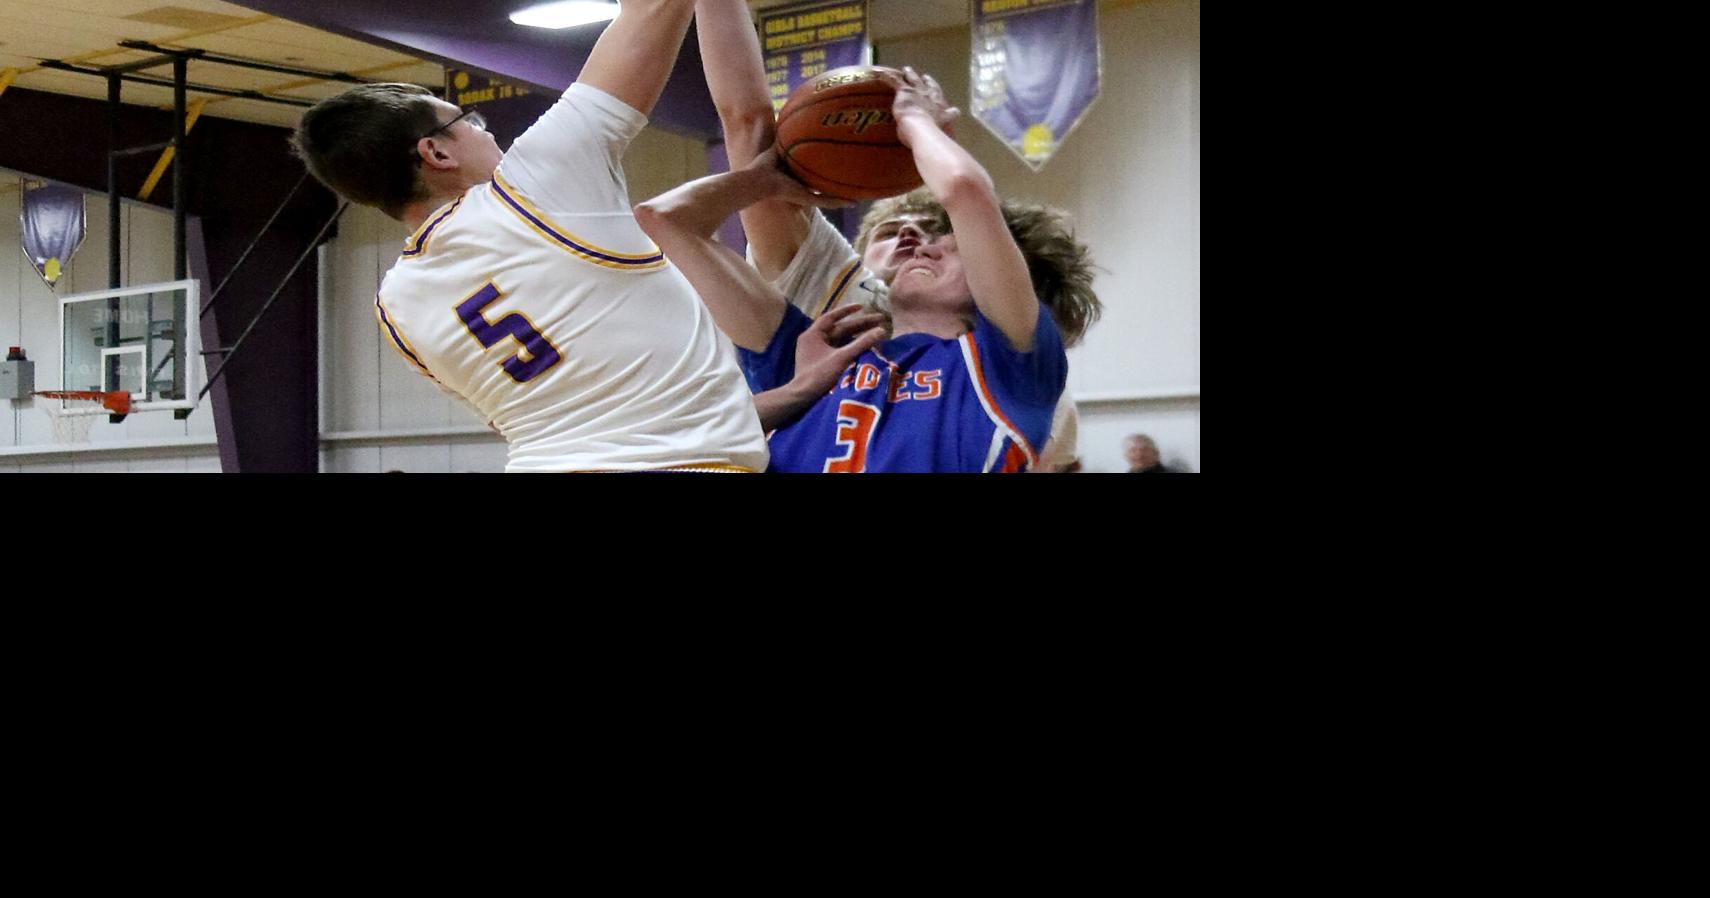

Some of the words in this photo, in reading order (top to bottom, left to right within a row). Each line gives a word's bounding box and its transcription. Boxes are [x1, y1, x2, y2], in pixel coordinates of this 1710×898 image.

[766, 16, 795, 33] GIRLS
[797, 5, 863, 29] BASKETBALL
[766, 30, 816, 49] DISTRICT
[818, 22, 862, 39] CHAMPS
[452, 276, 566, 384] 5
[822, 399, 882, 473] 3
